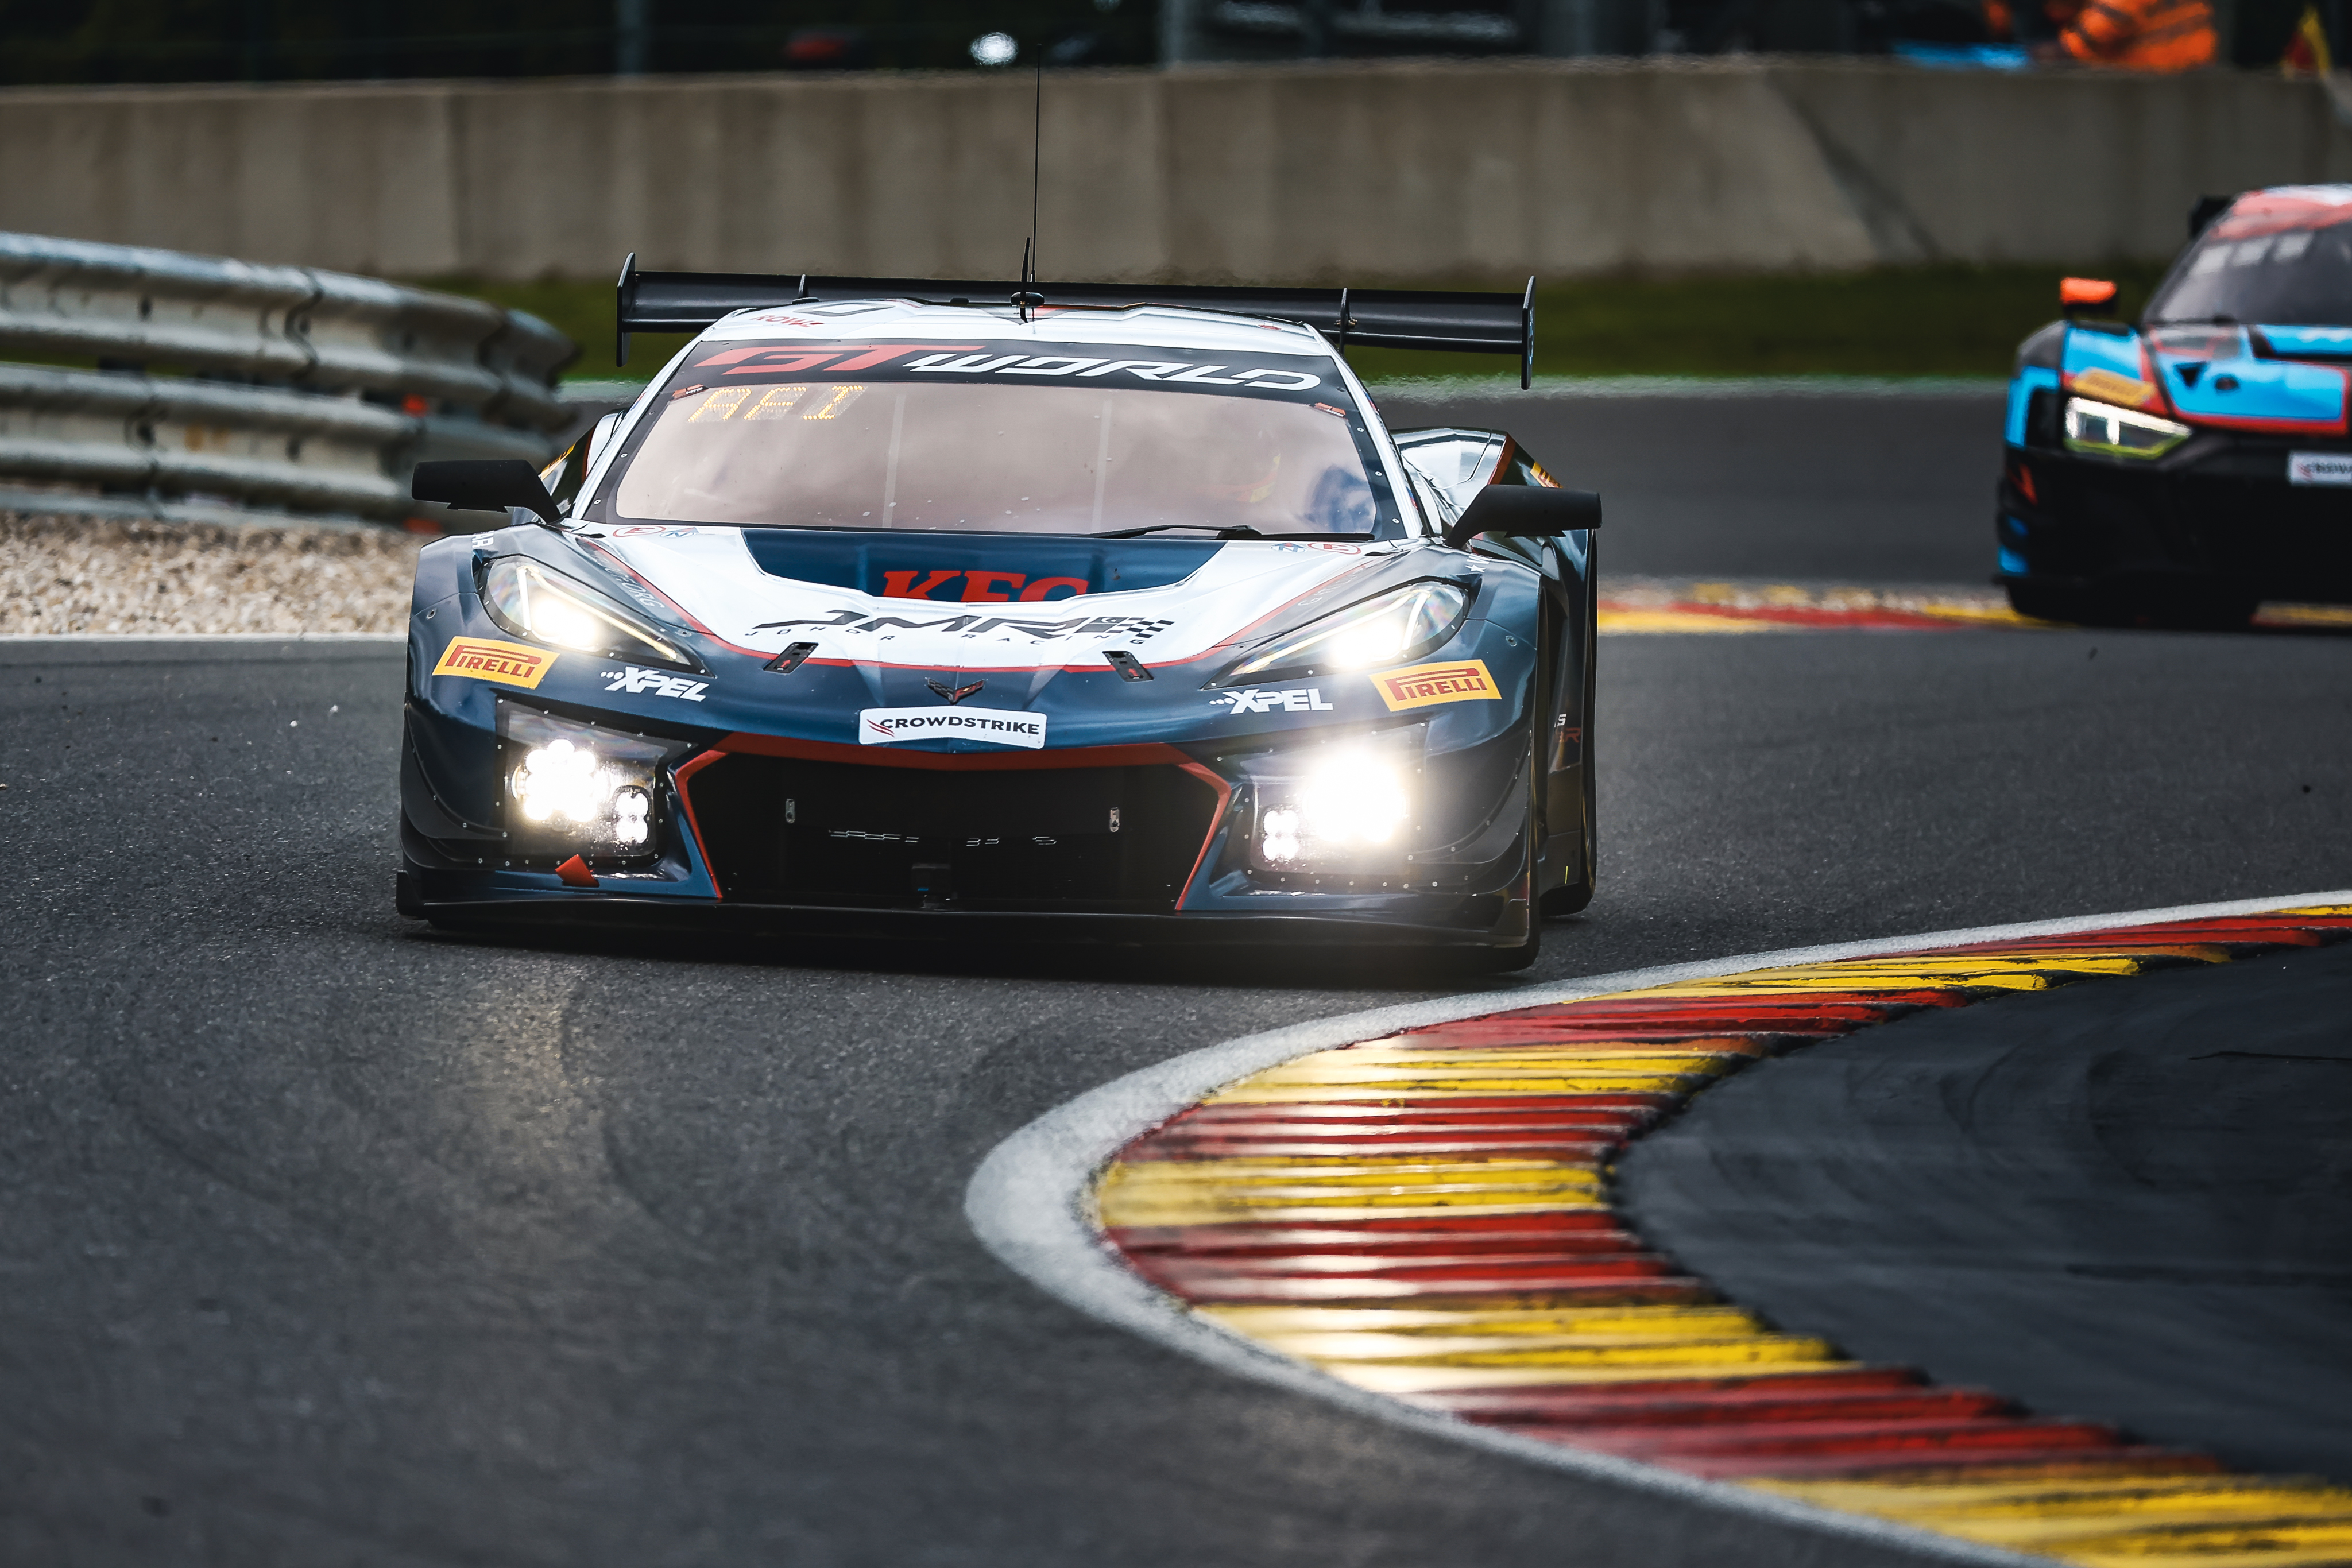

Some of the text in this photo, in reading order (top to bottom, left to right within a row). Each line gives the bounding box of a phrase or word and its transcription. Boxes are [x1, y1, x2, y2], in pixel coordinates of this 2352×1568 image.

[694, 344, 1321, 391] GT WORLD
[961, 633, 1146, 645] RACING
[445, 644, 541, 678] PIRELLI
[604, 666, 709, 702] XPEL
[1223, 688, 1334, 714] XPEL
[1385, 668, 1487, 702] PIRELLI
[880, 716, 1040, 735] CROWDSTRIKE
